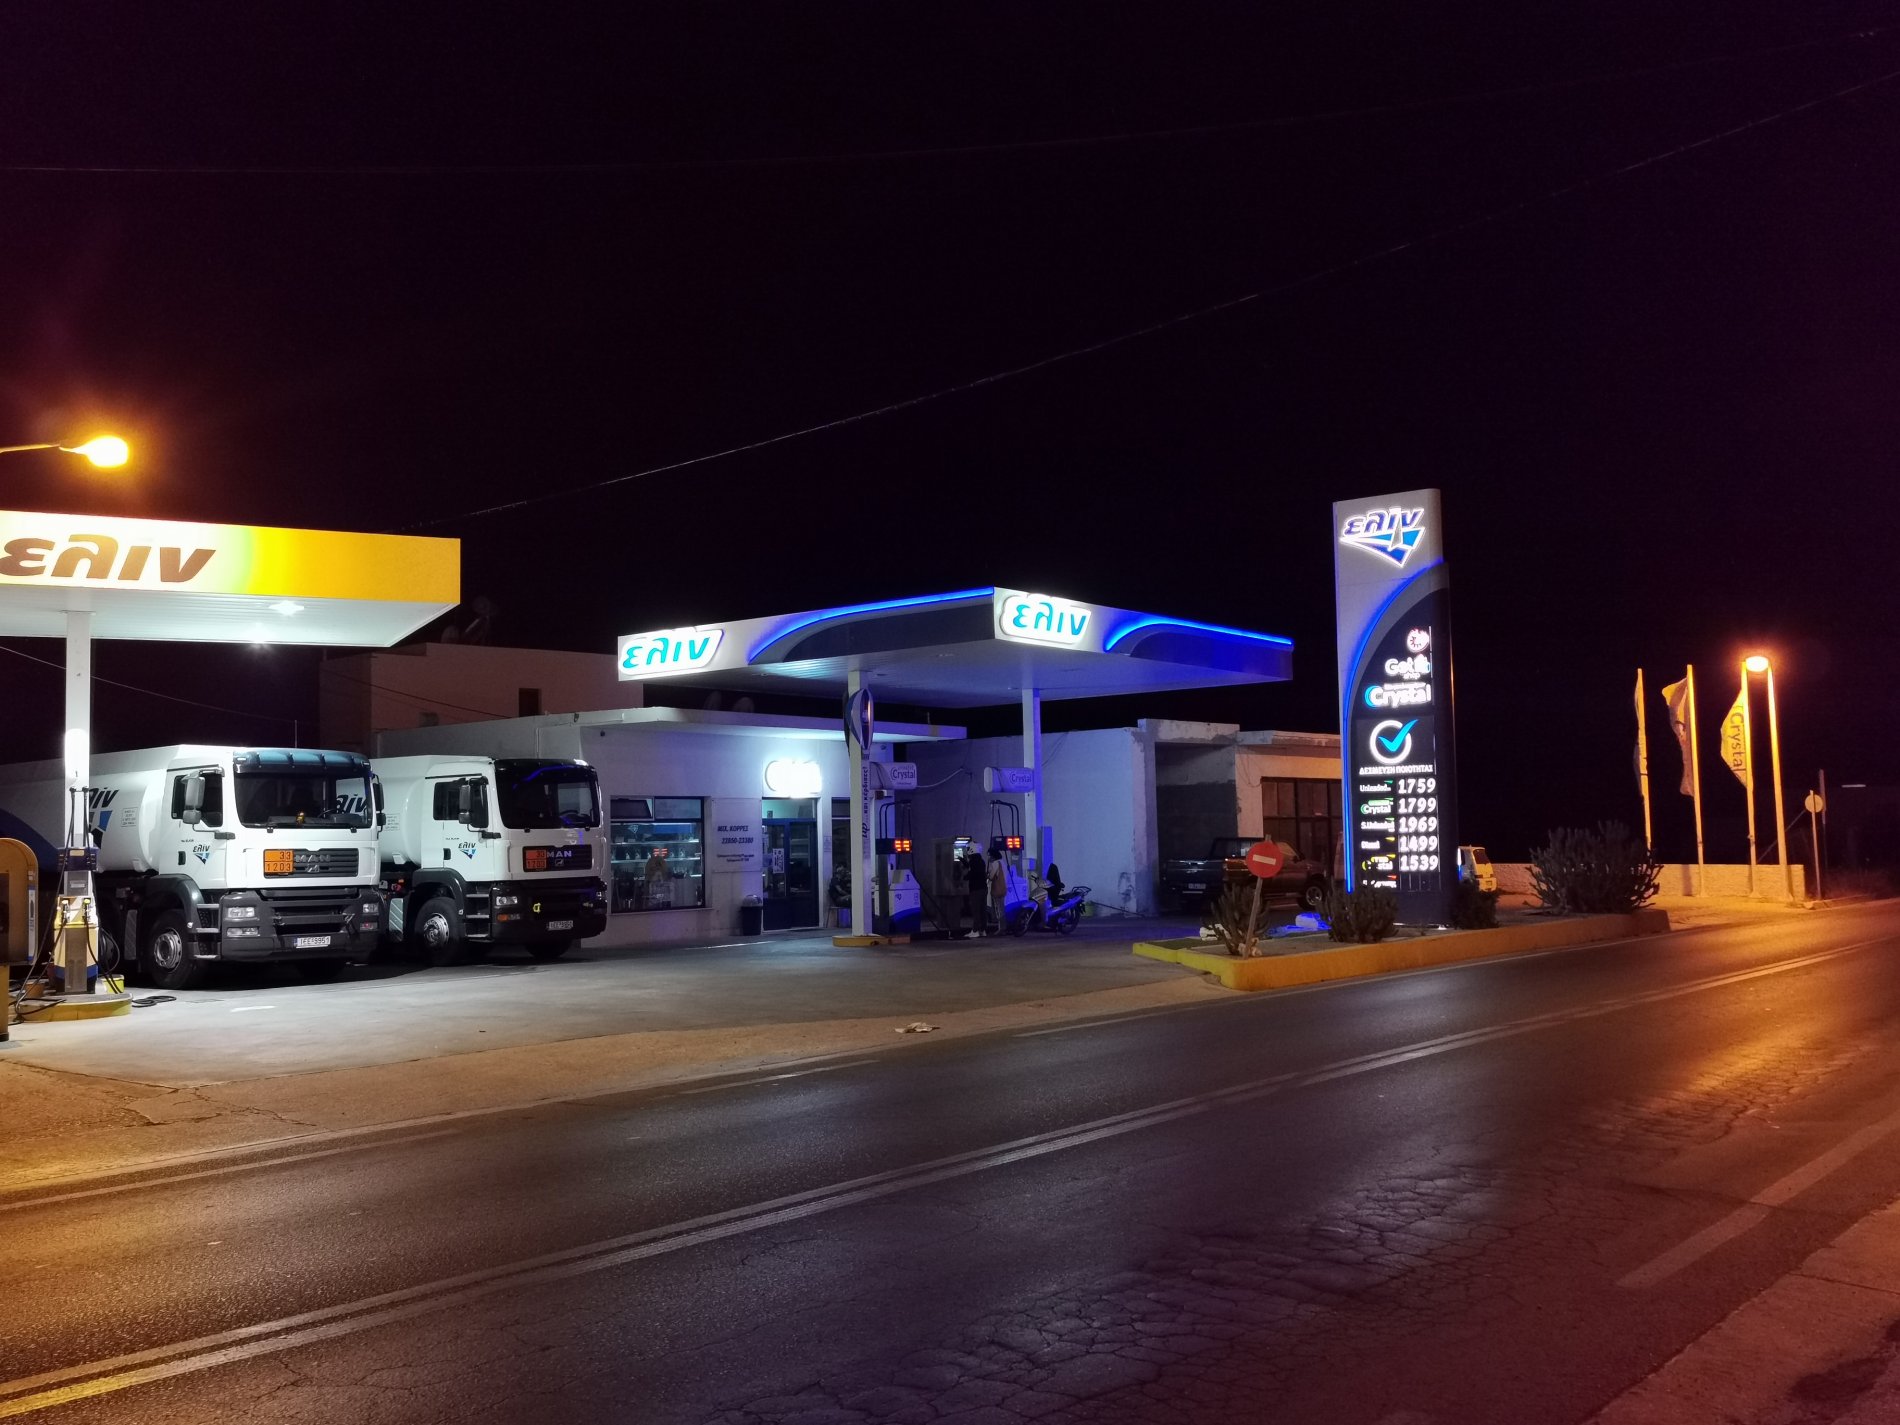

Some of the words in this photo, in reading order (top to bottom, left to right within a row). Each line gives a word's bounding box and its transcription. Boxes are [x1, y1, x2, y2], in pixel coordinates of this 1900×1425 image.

[1368, 684, 1432, 708] Crystal
[892, 768, 915, 780] Crystal
[1398, 777, 1436, 794] 1759
[1398, 797, 1437, 814] 1799
[1399, 816, 1437, 833] 1969
[1400, 835, 1438, 852] 1499
[280, 851, 291, 859] 33
[294, 854, 331, 863] MAN
[546, 850, 572, 858] MAN
[1400, 854, 1439, 871] 1539
[267, 863, 291, 871] 1203
